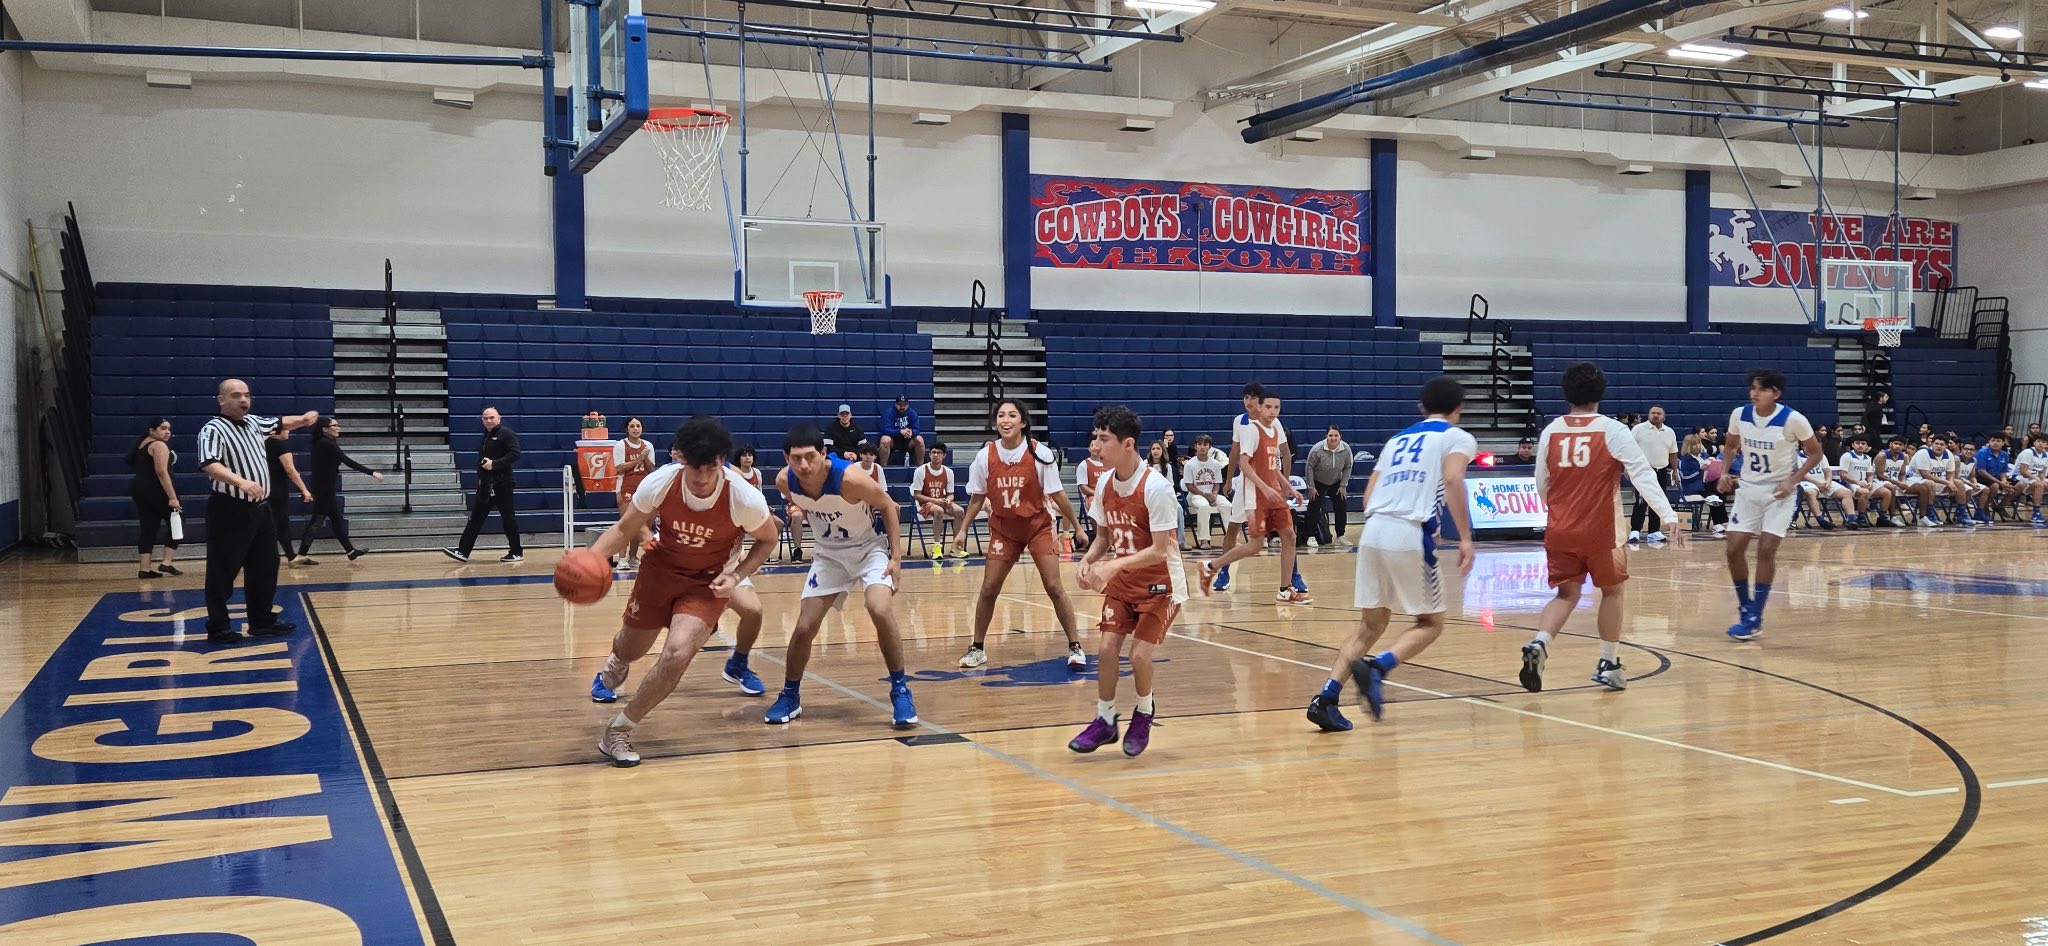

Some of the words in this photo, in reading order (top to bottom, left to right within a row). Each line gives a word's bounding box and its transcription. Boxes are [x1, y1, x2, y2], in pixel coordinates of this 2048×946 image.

[1035, 194, 1182, 244] COWBOYS
[1212, 196, 1361, 254] COWGIRLS
[1808, 214, 1864, 244] WE
[1882, 215, 1953, 247] ARE
[1750, 241, 1954, 292] COWBOYS
[591, 454, 604, 467] G
[1391, 434, 1426, 467] 24
[1558, 436, 1591, 468] 15
[1750, 452, 1771, 473] 21
[997, 476, 1025, 489] ALICE
[1492, 484, 1521, 493] HOME
[1523, 484, 1535, 492] OF
[1001, 489, 1021, 509] 14
[1494, 492, 1549, 515] COW
[673, 520, 714, 539] ALICE
[1112, 528, 1138, 555] 21
